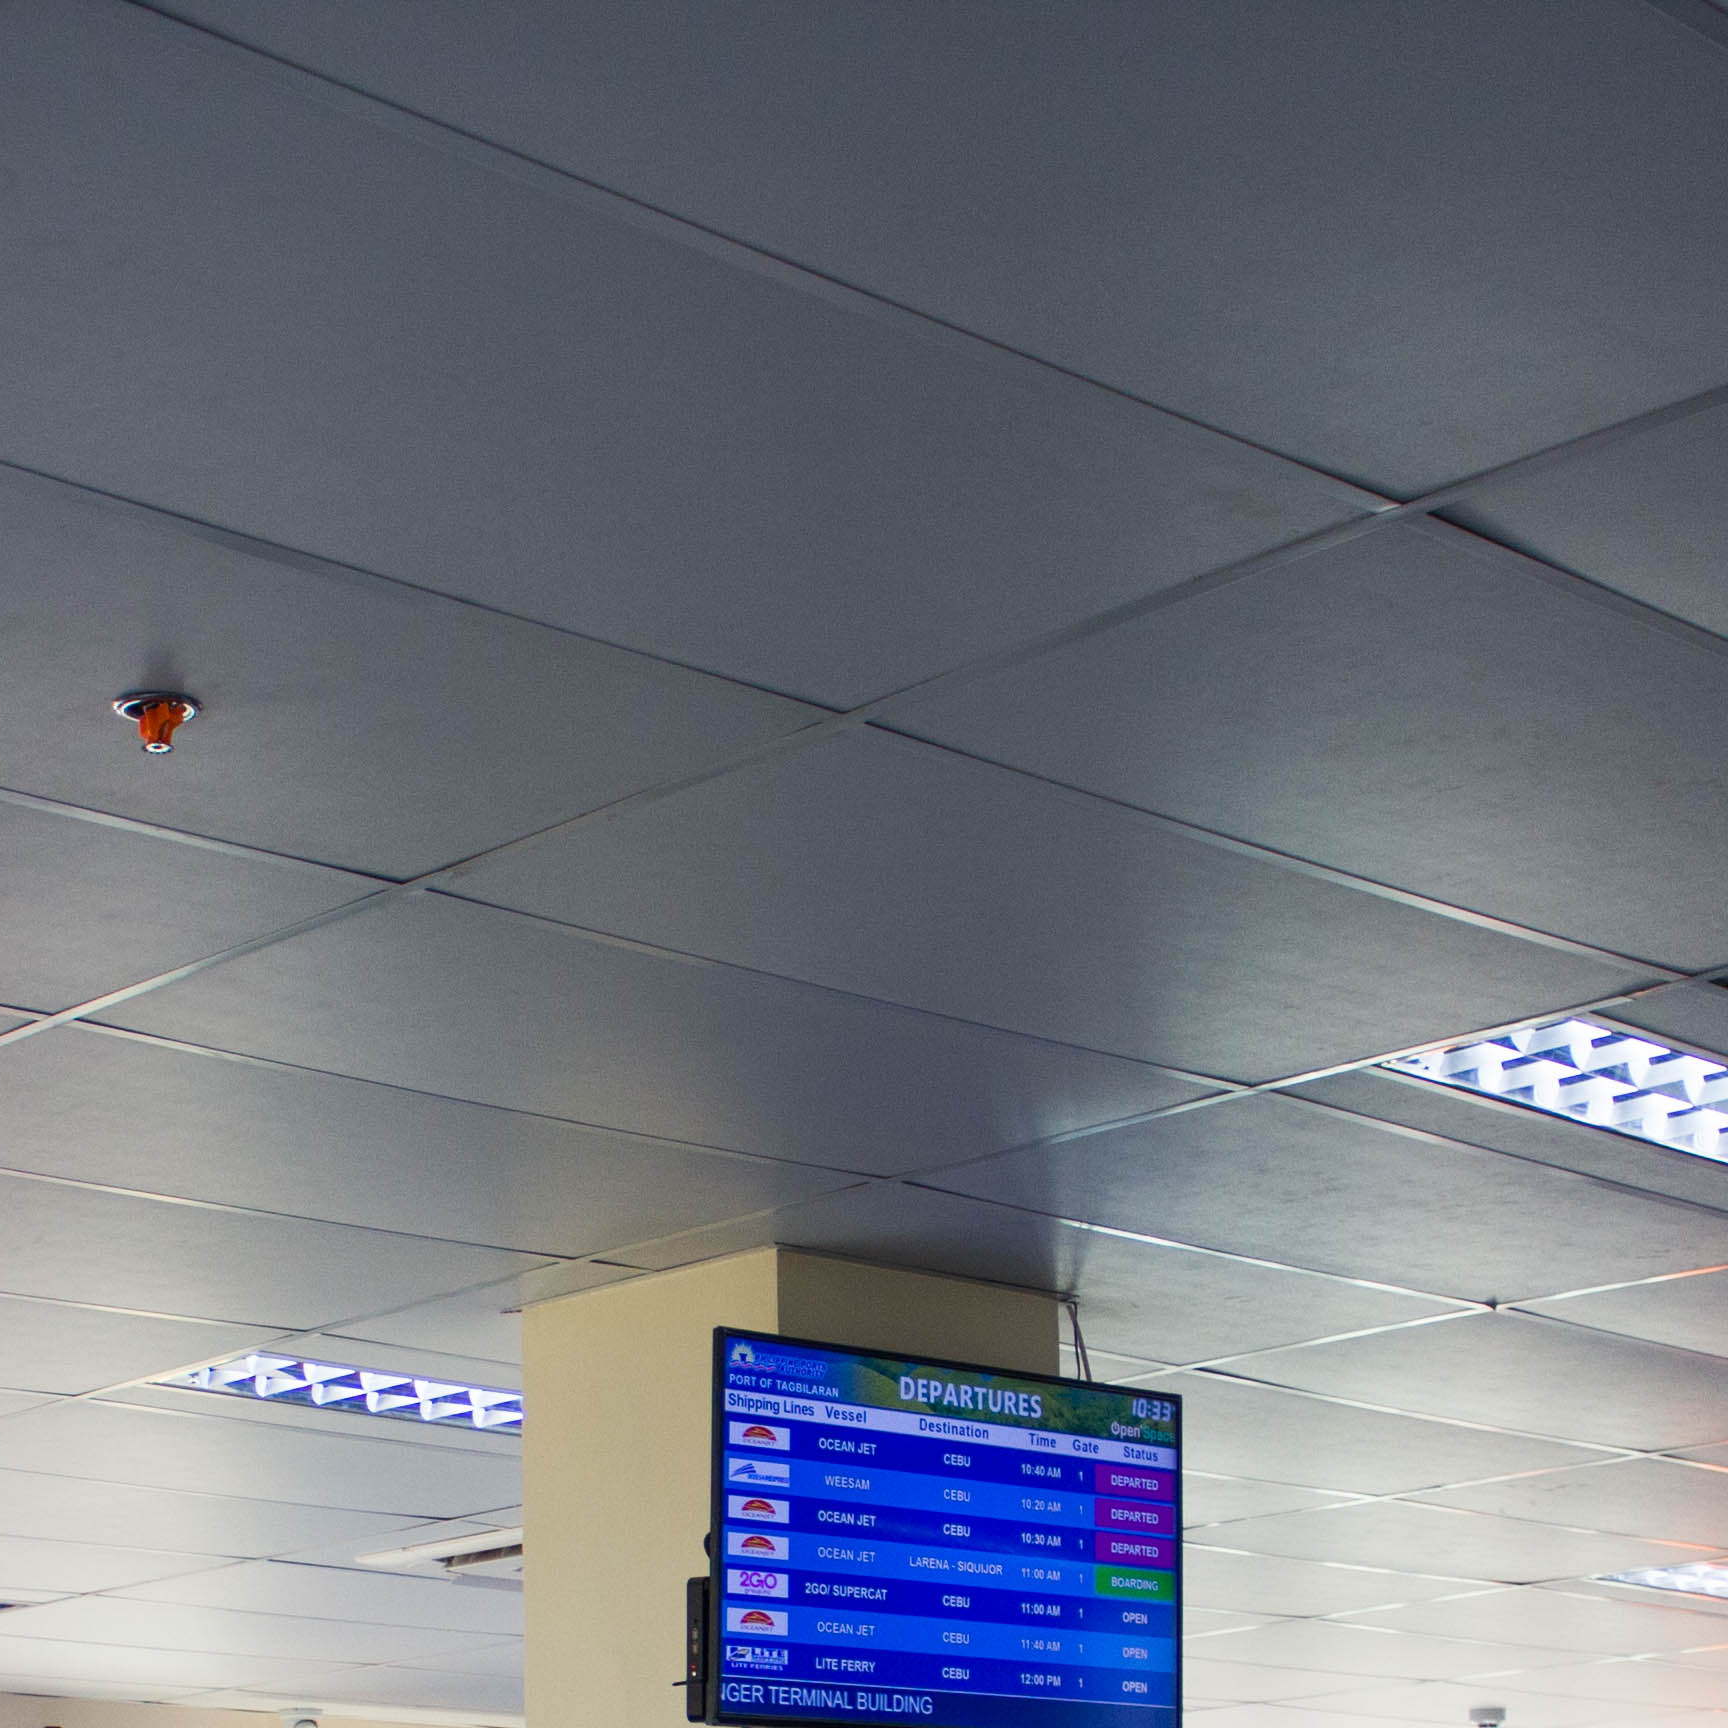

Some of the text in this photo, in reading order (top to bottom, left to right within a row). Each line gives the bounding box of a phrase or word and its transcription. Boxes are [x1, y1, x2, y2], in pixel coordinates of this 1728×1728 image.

[729, 1373, 839, 1398] PORT OF TAGBILARAN
[899, 1376, 1042, 1419] DEPARTURES
[728, 1393, 1159, 1462] Shipping Lines Vessel Destination Time Gate Status
[818, 1437, 1159, 1491] OCEAN JET CEBU 10:40 AM 1 DEPARTED
[824, 1474, 870, 1491] WEESAM
[943, 1488, 971, 1503] CEBU
[1047, 1501, 1061, 1514] AM
[1078, 1505, 1084, 1516] 1
[1110, 1508, 1159, 1525] DEPARTED
[817, 1509, 1159, 1559] OCEAN JET CEBU 10:30 AM 1 DEPARTED
[739, 1571, 778, 1591] 2GO
[817, 1546, 854, 1561] OCEAN
[856, 1550, 876, 1564] JET
[909, 1555, 950, 1571] LARENA
[957, 1560, 1003, 1577] SIQUIJOR
[1021, 1567, 1045, 1581] 11:00
[1046, 1569, 1061, 1582] AM
[1078, 1573, 1084, 1584] 1
[1110, 1576, 1159, 1592] BOARDING
[805, 1581, 1148, 1626] 2GO/ SUPERCAT CEBU 11:00 AM 1 OPEN
[817, 1620, 1148, 1660] OCEAN JET CEBU 11:40 AM 1 OPEN
[815, 1656, 1148, 1694] LITE FERRY CEBU 12:00 PM 1 OPEN
[767, 1685, 854, 1710] TERMINAL
[857, 1691, 934, 1716] BUILDING
